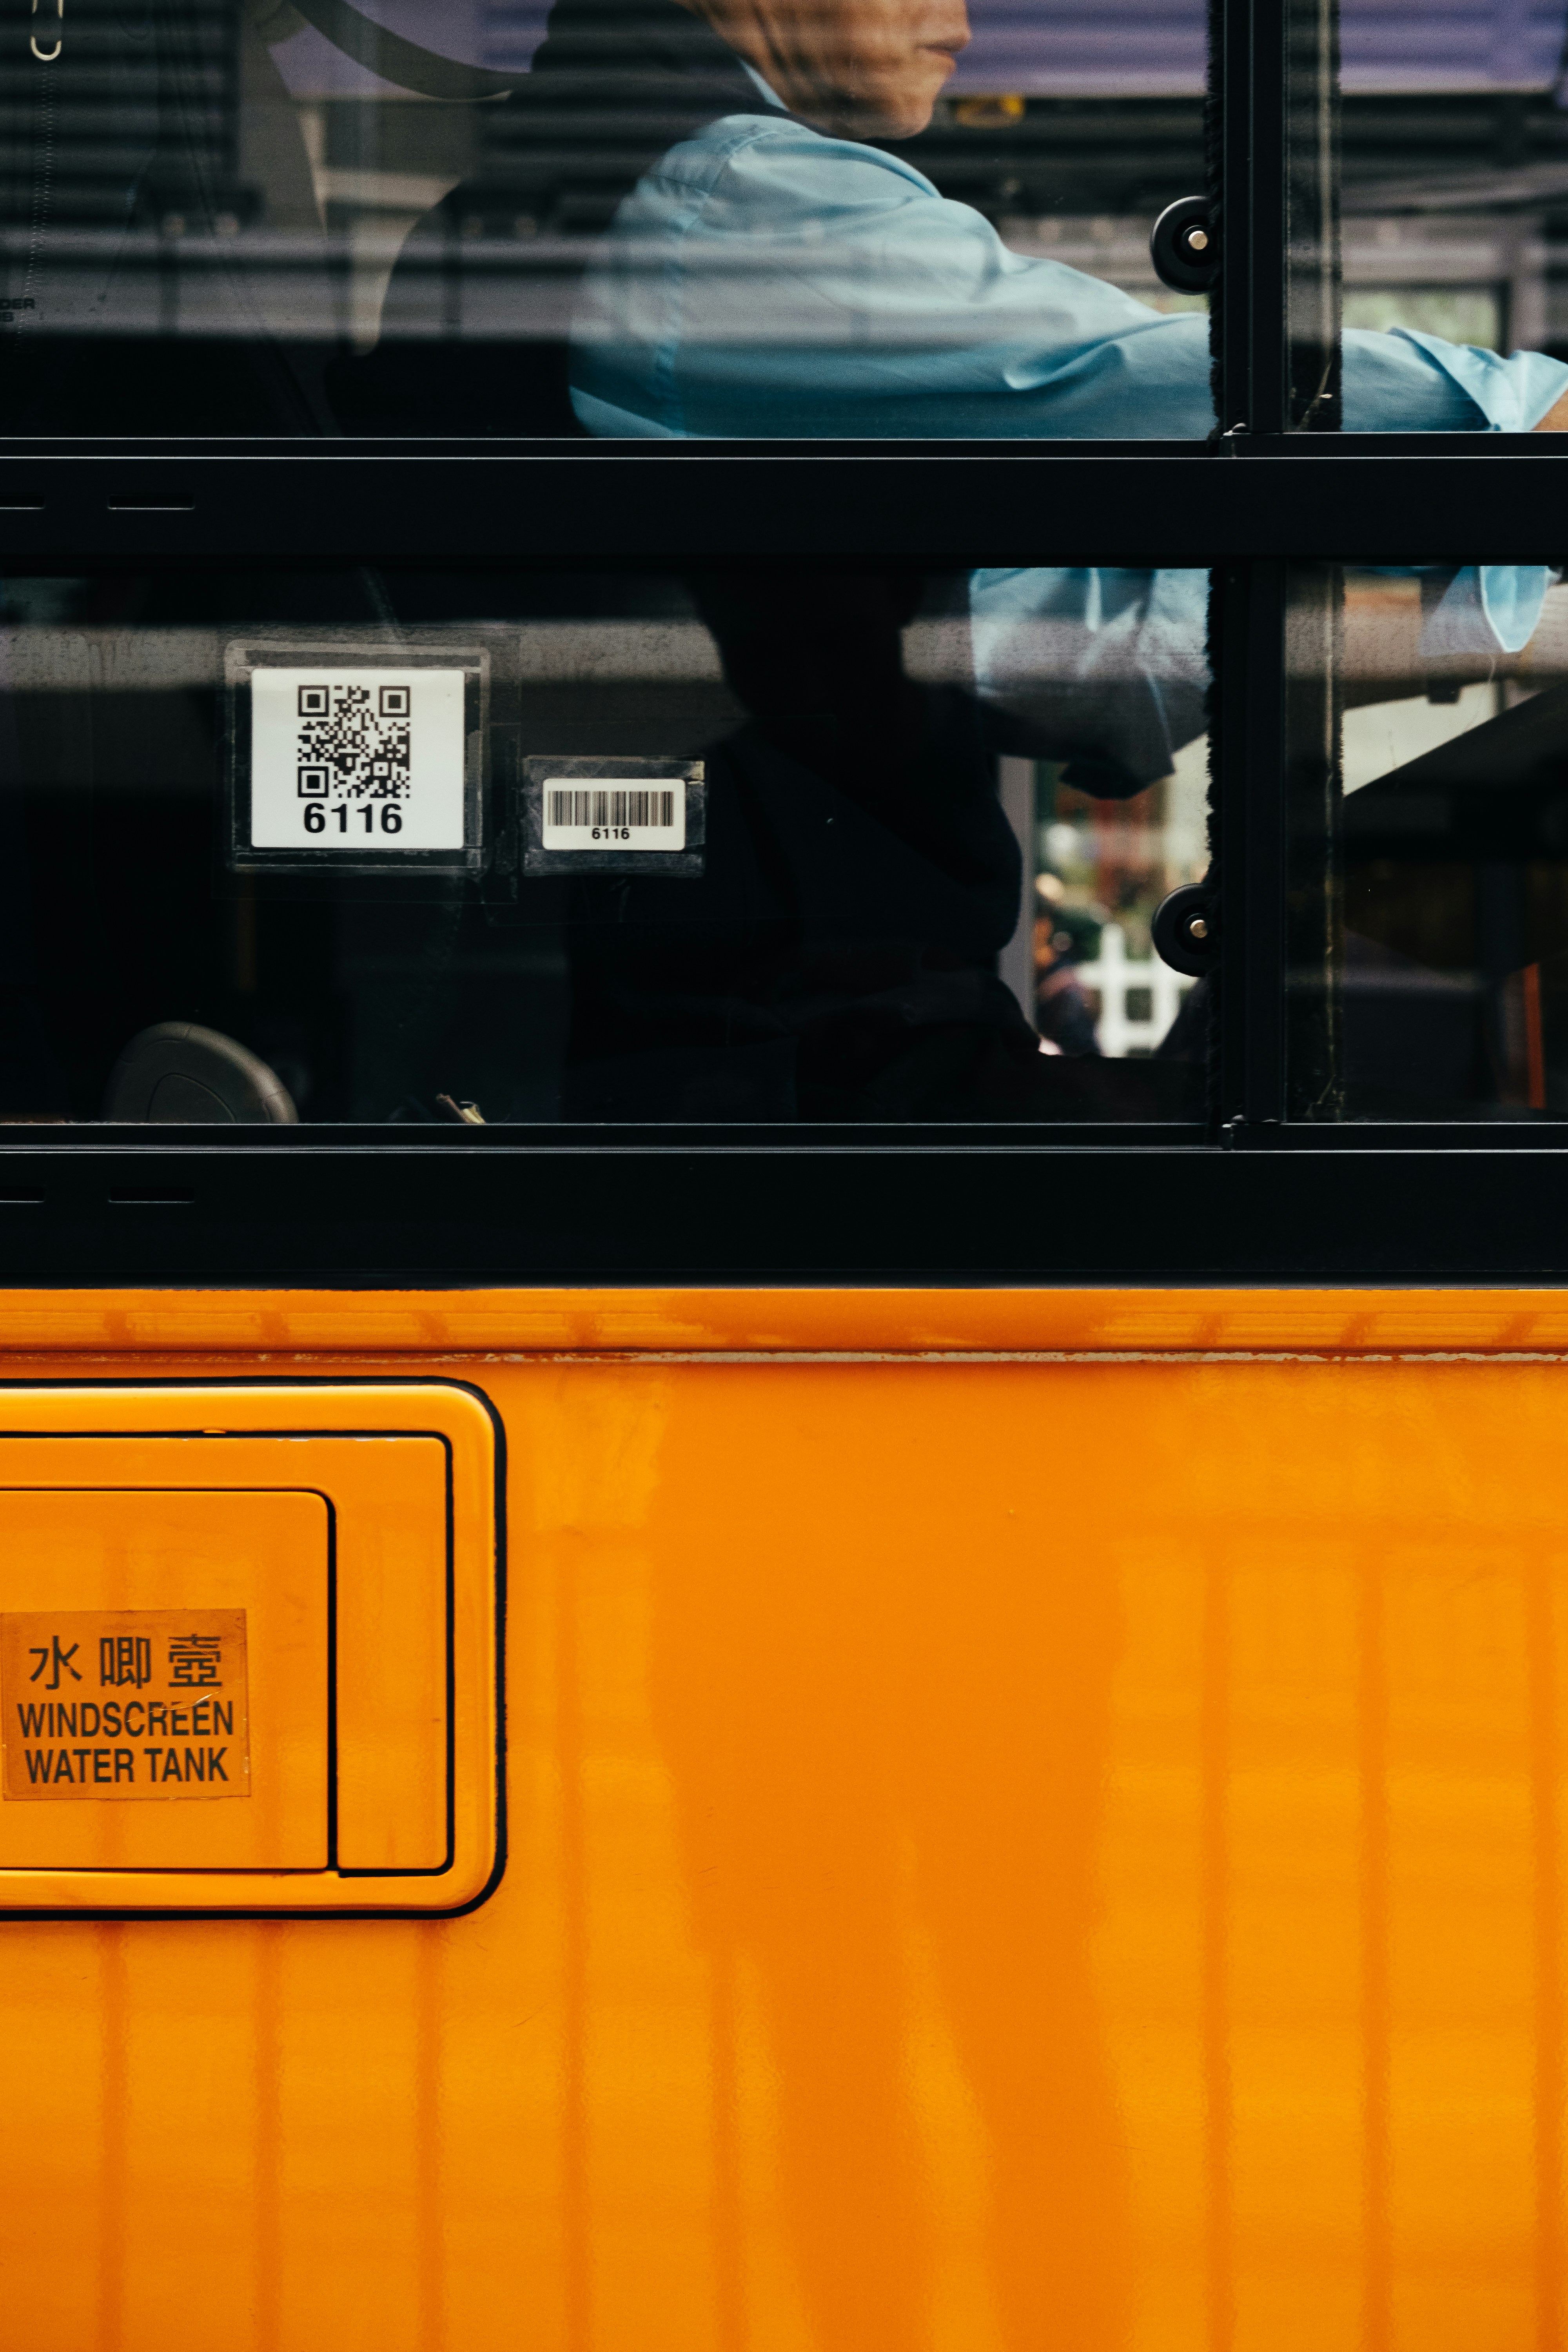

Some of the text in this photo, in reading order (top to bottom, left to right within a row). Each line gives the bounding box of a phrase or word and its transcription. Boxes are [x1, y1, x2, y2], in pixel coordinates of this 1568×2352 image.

[303, 802, 403, 834] 6116
[591, 827, 630, 840] 6116
[29, 1634, 223, 1690] 水唧壺
[17, 1700, 233, 1738] WINDSCREEN
[25, 1747, 229, 1784] WATER TANK
